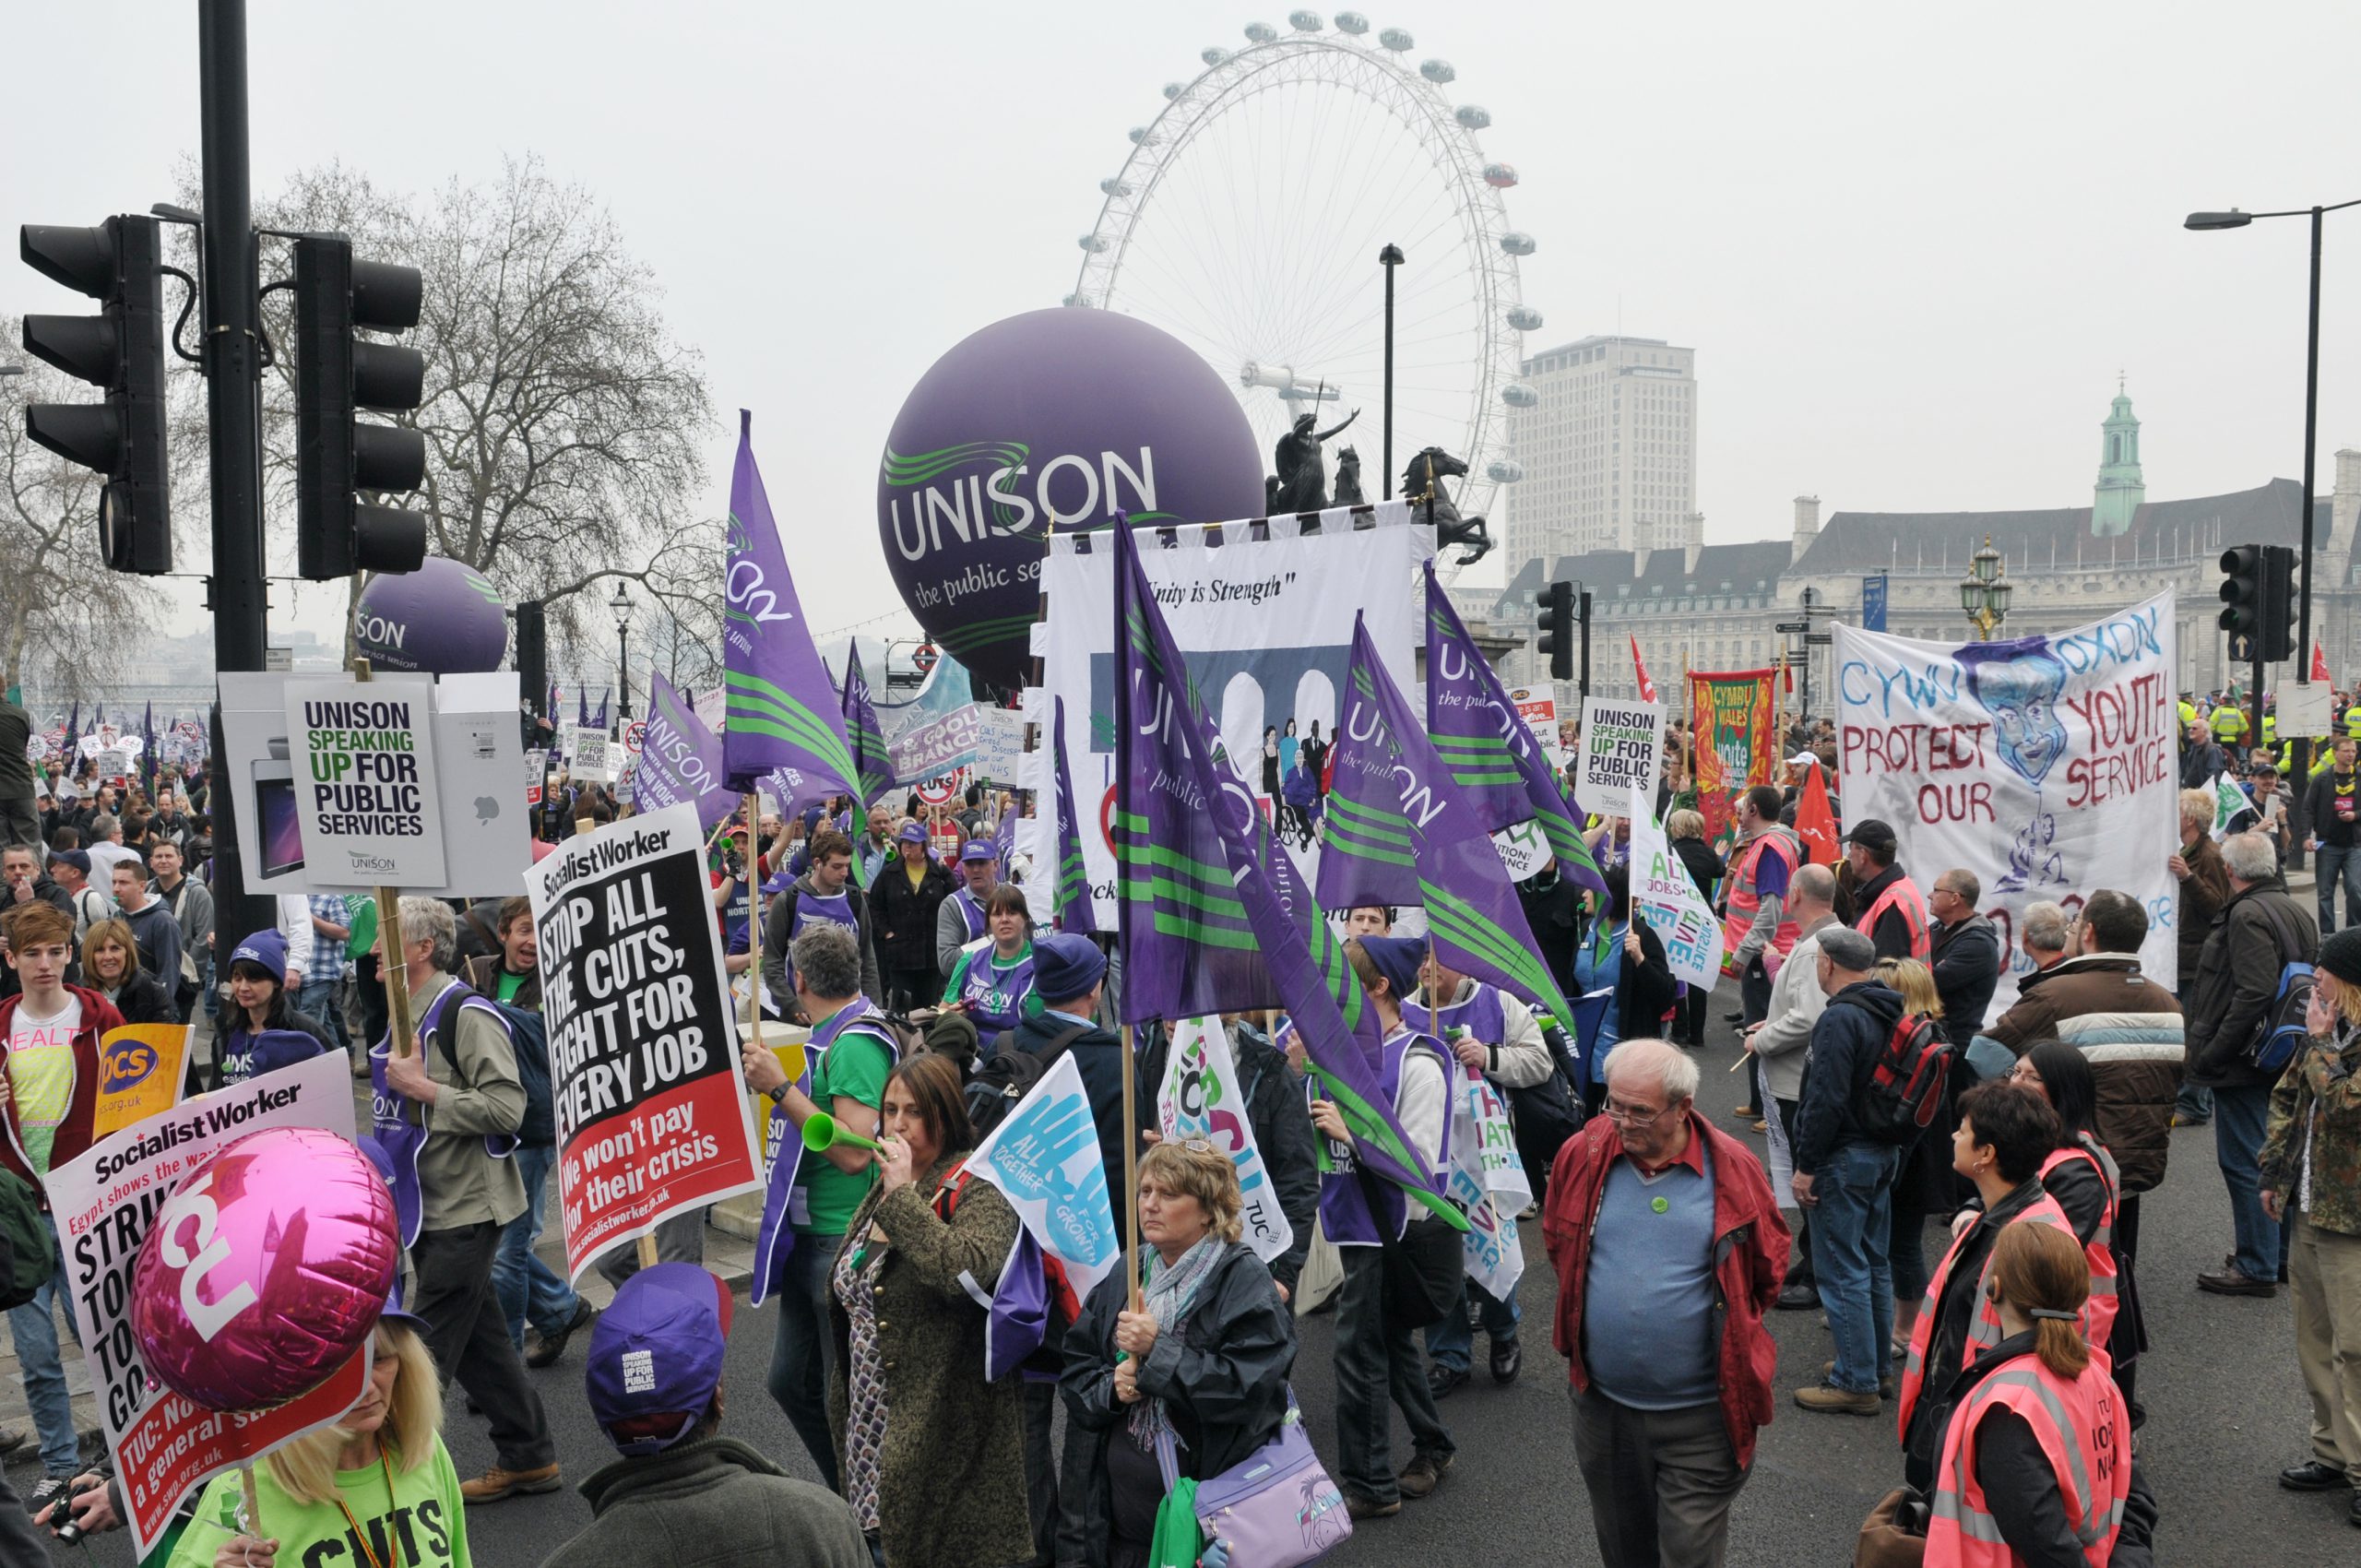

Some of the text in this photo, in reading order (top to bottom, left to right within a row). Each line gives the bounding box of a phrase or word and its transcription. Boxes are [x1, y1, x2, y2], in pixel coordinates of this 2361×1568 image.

[891, 446, 1157, 561] UNISON
[915, 583, 942, 609] the
[943, 563, 1010, 606] public
[1191, 580, 1204, 602] is
[354, 612, 406, 648] SON
[387, 652, 418, 670] union
[1439, 690, 1461, 706] the
[1512, 690, 1530, 700] pcs
[1714, 685, 1751, 707] CYMRU
[1841, 661, 1960, 718] CYWU
[304, 701, 410, 729] UNISON
[1594, 708, 1655, 730] UNISON
[1719, 707, 1748, 727] WALES
[2067, 670, 2167, 754] YOUTH
[308, 730, 414, 752] SPEAKING
[578, 731, 606, 741] UNISON
[628, 736, 644, 744] CUT
[633, 727, 646, 735] NO
[1592, 725, 1654, 742] SPEAKING
[577, 745, 605, 754] UP FOR
[898, 728, 979, 771] BRANCH
[1540, 740, 1556, 749] blic
[1591, 737, 1653, 760] UP FOR
[1717, 741, 1748, 766] unite
[1844, 721, 1991, 775] PROTECT
[310, 752, 418, 783] UP FOR
[576, 754, 605, 763] PUBLIC
[644, 743, 681, 788] NORTH WEST
[990, 763, 1009, 777] NHS
[1589, 755, 1650, 778] PUBLIC
[2067, 735, 2166, 807] SERVICE
[919, 777, 953, 791] CUTS
[1150, 769, 1206, 811] public
[1587, 772, 1648, 790] SERVICES
[314, 784, 421, 814] PUBLIC
[1917, 781, 1996, 825] OUR
[318, 814, 423, 836] SERVICES
[351, 857, 396, 870] UNISON
[541, 872, 667, 976] STOP ALL
[727, 908, 752, 918] NORT
[546, 924, 685, 1033] THE CUTS,
[965, 983, 1014, 1007] UNISON
[13, 1028, 80, 1052] EALT
[552, 974, 698, 1092] FIGHT FOR
[102, 1049, 149, 1084] pcs
[222, 1074, 250, 1086] eakin
[556, 1026, 707, 1147] EVERY JOB
[562, 1100, 694, 1197] We won't pay
[1012, 1134, 1046, 1168] ALL
[993, 1145, 1044, 1192] TOGETHER
[68, 1198, 103, 1237] Egypt
[108, 1171, 150, 1206] shows
[156, 1158, 181, 1182] the
[565, 1196, 583, 1240] for
[587, 1163, 646, 1214] their
[648, 1132, 718, 1182] crisis
[1079, 1207, 1099, 1242] FOR
[1246, 1199, 1269, 1238] TUC
[1056, 1204, 1097, 1263] GROWTH
[93, 1318, 134, 1384] TO
[622, 1349, 652, 1362] UNISON
[623, 1365, 654, 1378] UP FOR
[624, 1374, 655, 1386] PUBLIC
[625, 1383, 656, 1395] SERVICES
[2098, 1396, 2111, 1415] TU
[123, 1418, 162, 1476] TUC:
[134, 1484, 146, 1508] a
[148, 1411, 222, 1493] general
[144, 1446, 222, 1536] www.swp.org.uk
[302, 1499, 450, 1568] CUTS
